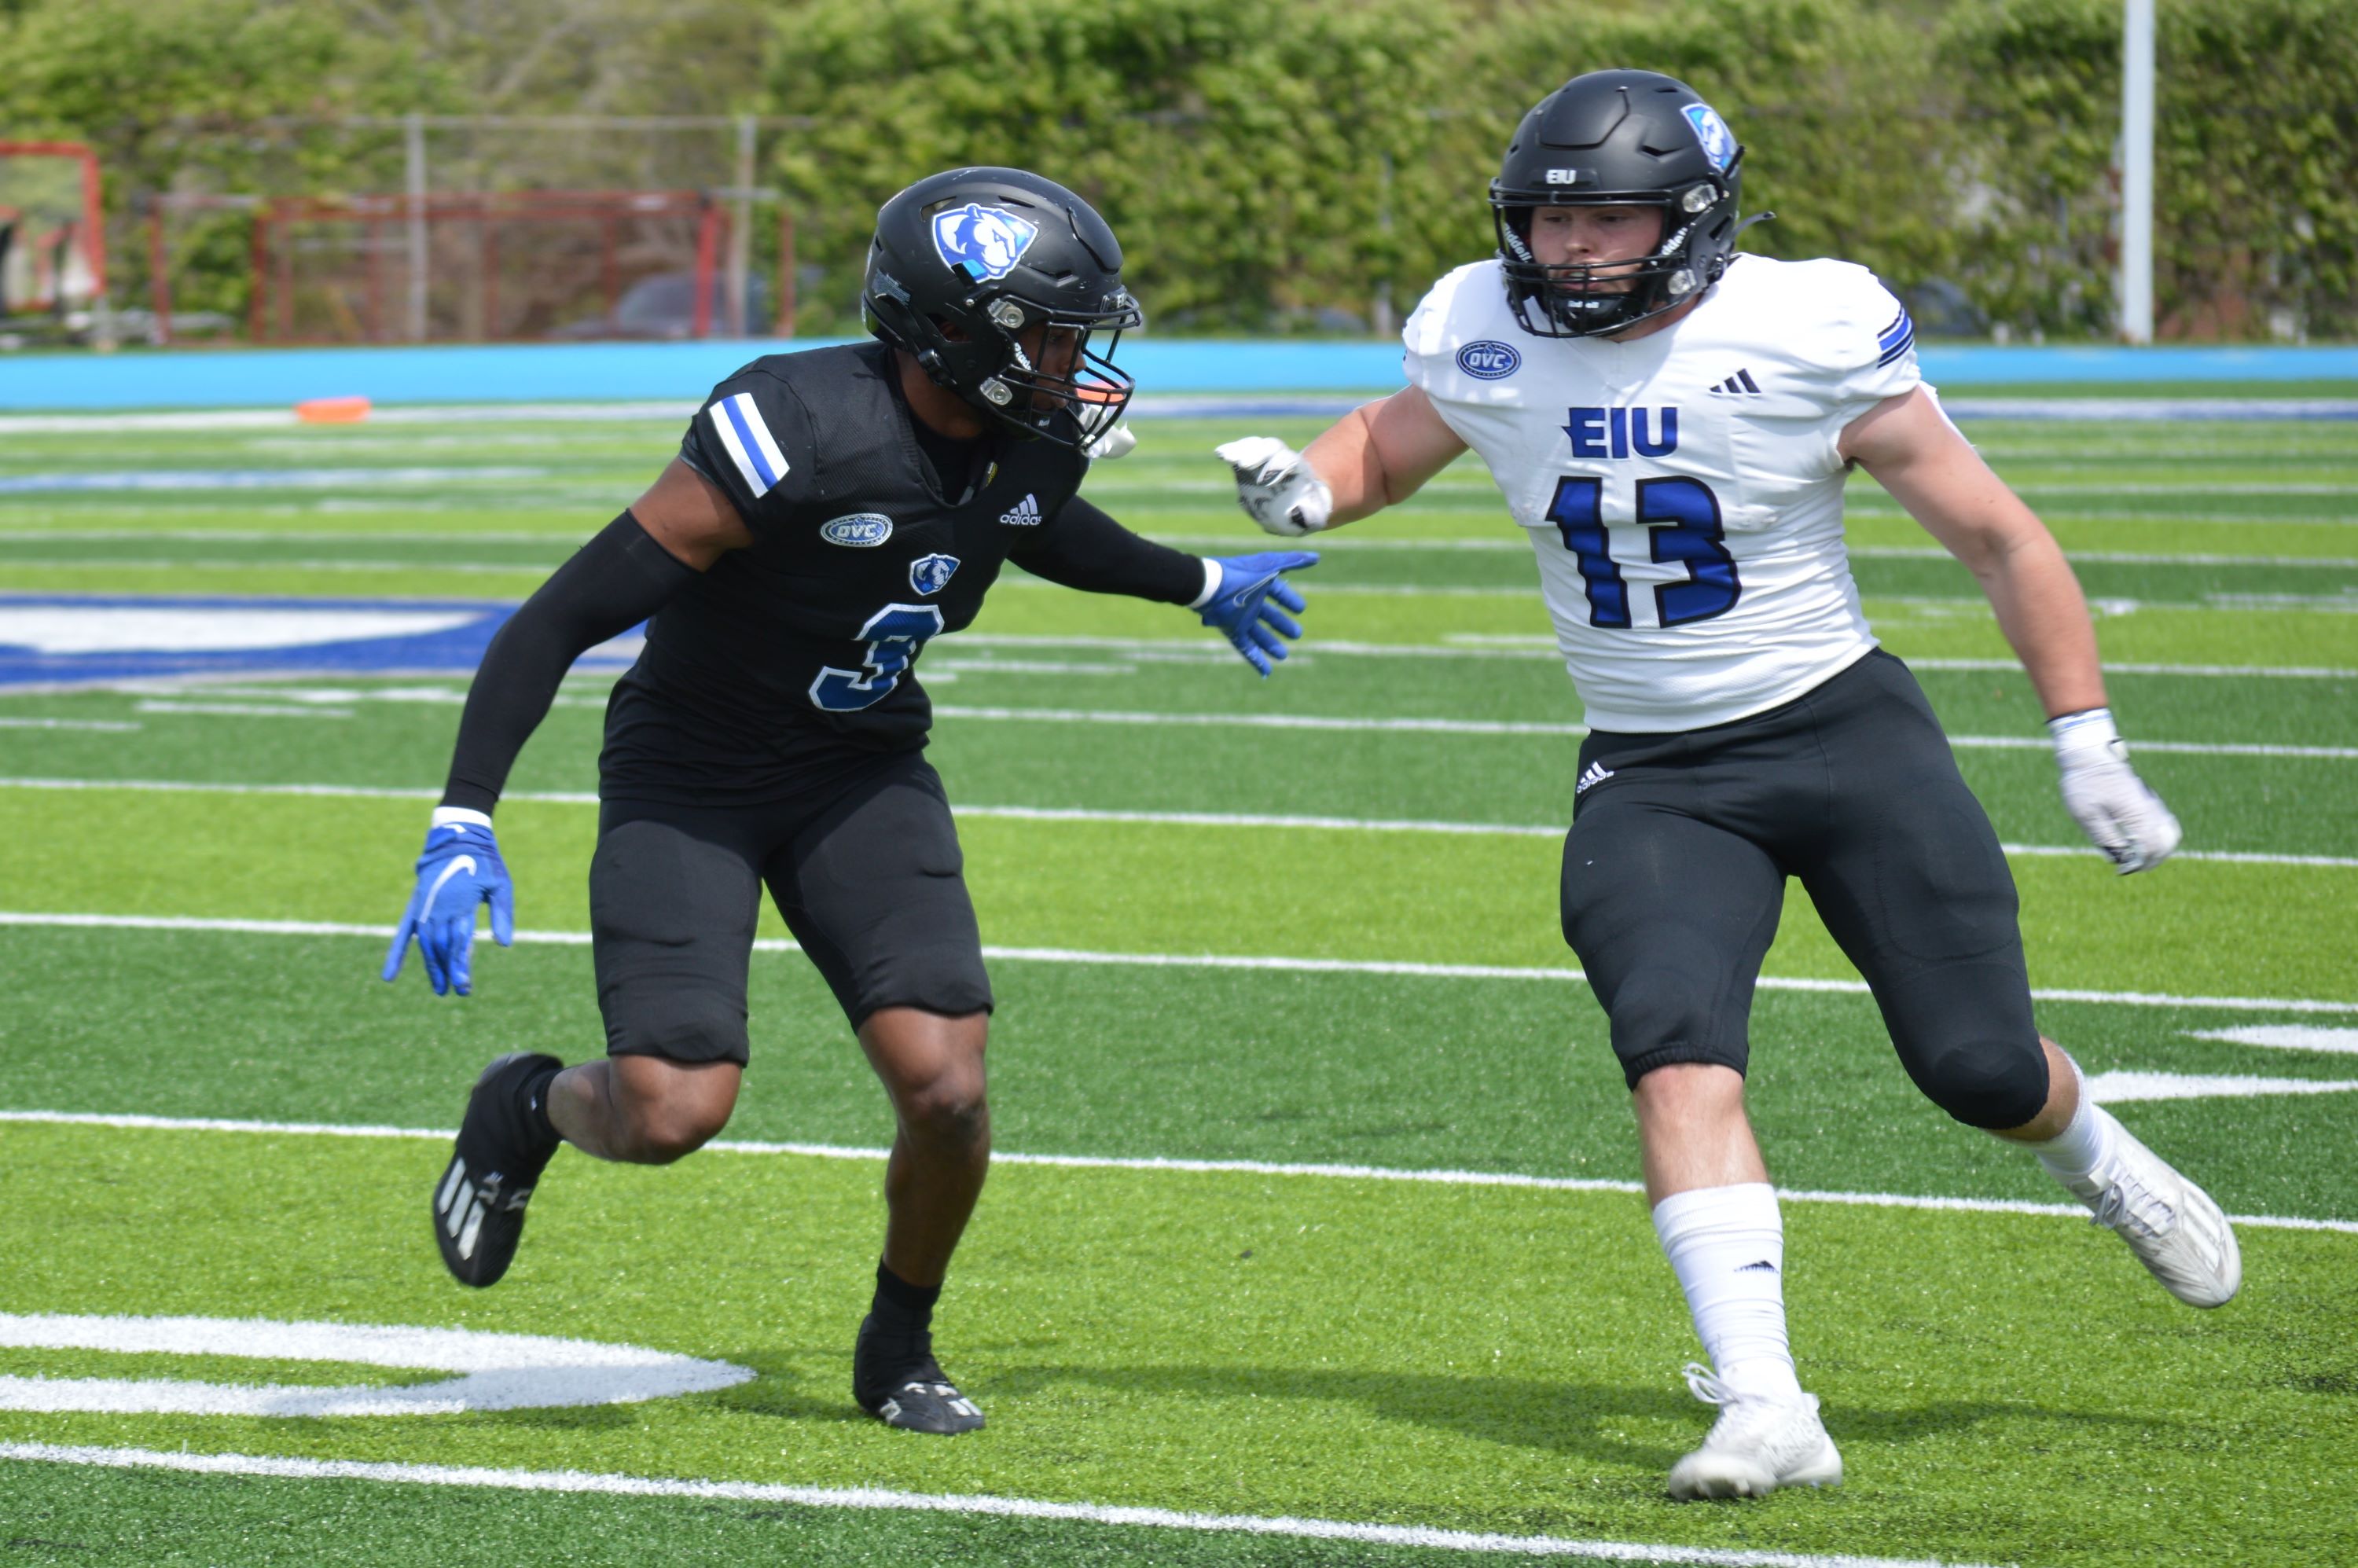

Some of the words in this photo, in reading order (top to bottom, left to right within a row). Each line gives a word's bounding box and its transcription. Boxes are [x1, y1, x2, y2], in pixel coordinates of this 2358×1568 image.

[1546, 169, 1577, 185] EIU
[1469, 352, 1507, 369] OVC
[1561, 406, 1678, 459] EIU
[1000, 512, 1042, 525] adidas
[836, 523, 878, 538] OVC
[1544, 475, 1743, 629] 13
[808, 603, 946, 712] 3
